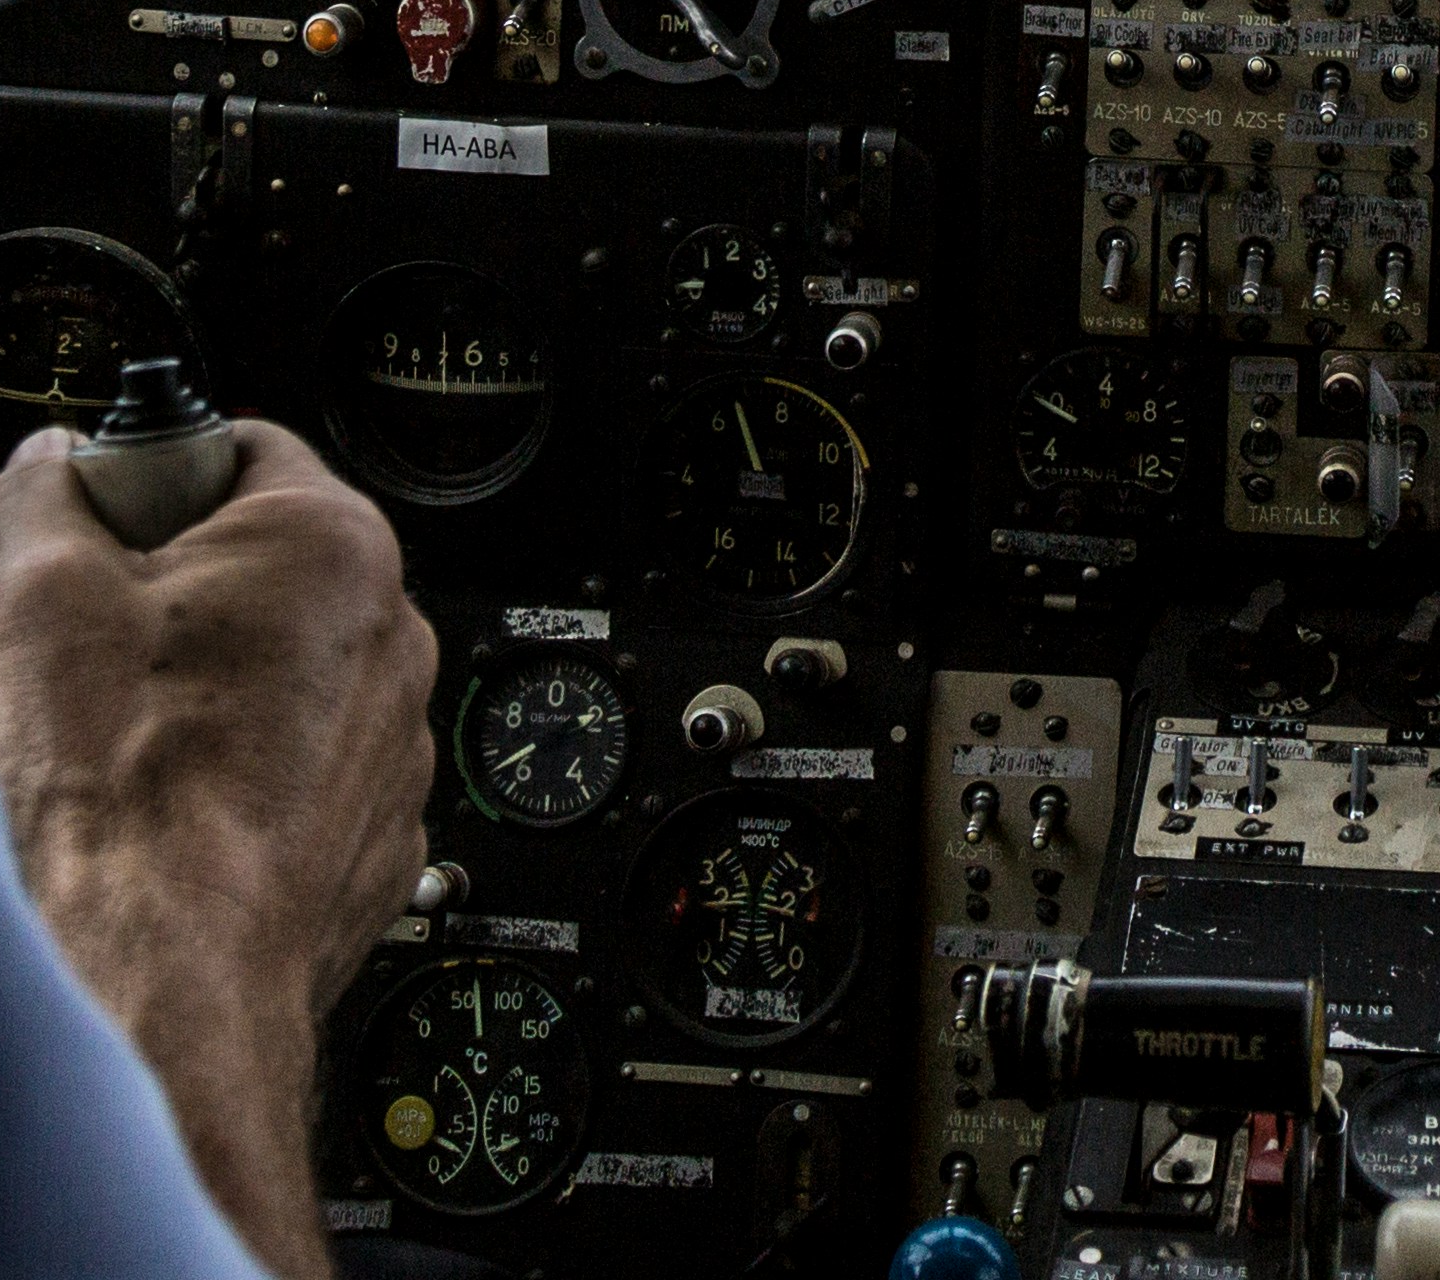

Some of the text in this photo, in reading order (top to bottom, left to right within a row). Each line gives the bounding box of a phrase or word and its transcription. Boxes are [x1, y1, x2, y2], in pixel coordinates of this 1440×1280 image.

[1092, 102, 1152, 122] AZS-10
[1162, 105, 1223, 127] AZS-10
[422, 132, 517, 161] HA-ABA
[1210, 842, 1302, 858] EXT PWR
[1326, 1002, 1394, 1016] RNING
[1134, 1028, 1266, 1062] THROTTLE
